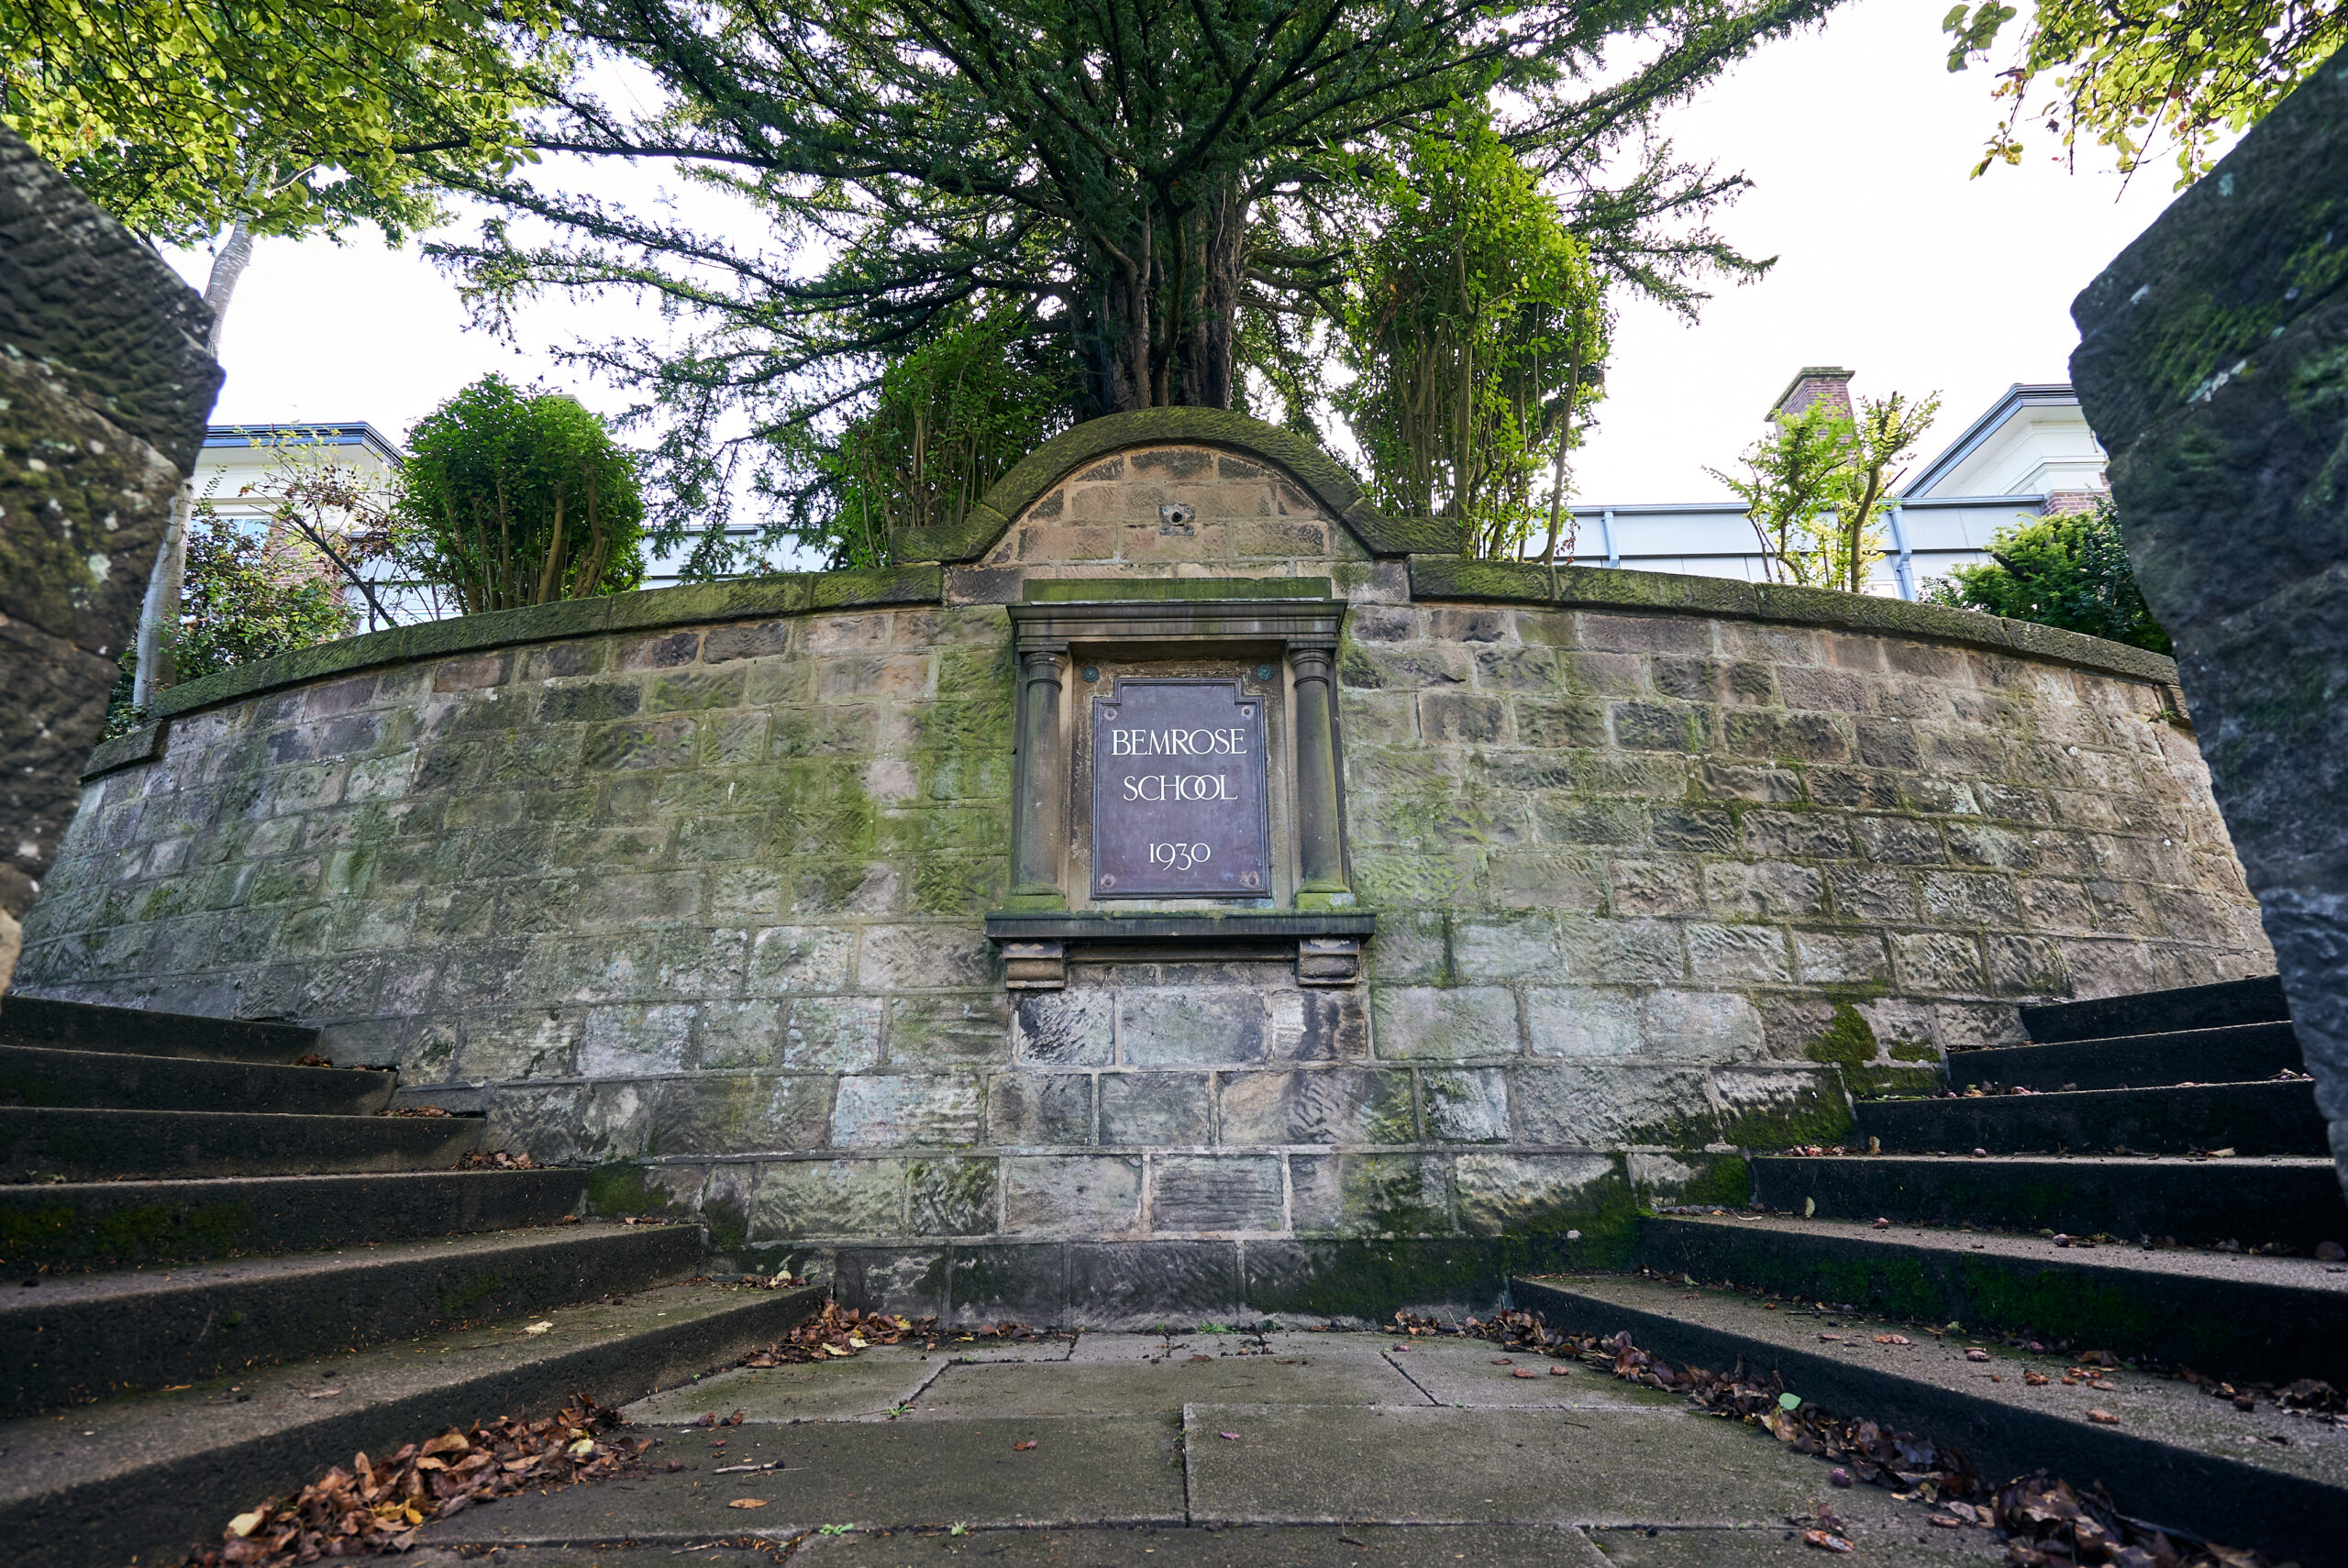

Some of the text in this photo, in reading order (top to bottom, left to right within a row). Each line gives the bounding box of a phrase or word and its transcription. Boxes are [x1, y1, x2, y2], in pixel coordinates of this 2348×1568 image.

[1112, 729, 1247, 756] BEMROSE
[1123, 775, 1238, 801] SCHOOL
[1148, 843, 1211, 871] 1930
